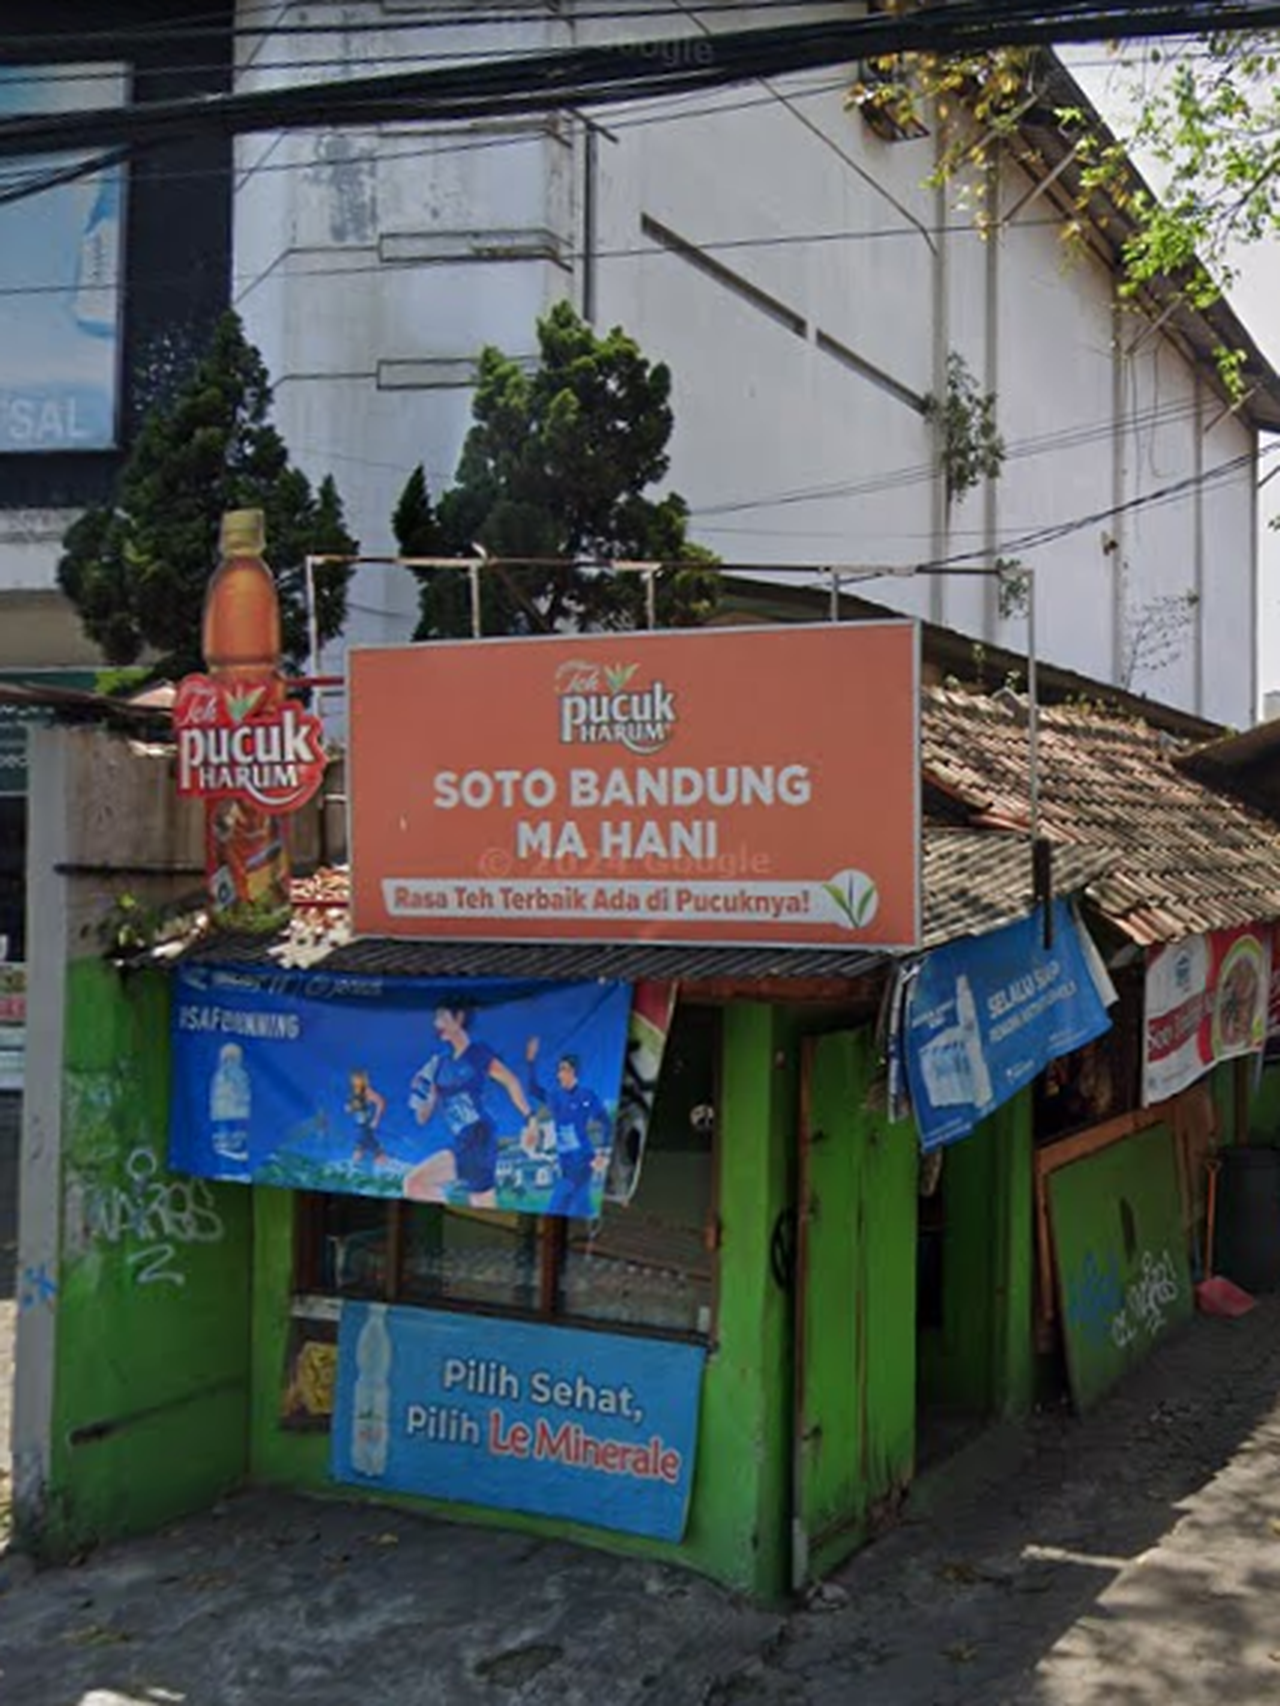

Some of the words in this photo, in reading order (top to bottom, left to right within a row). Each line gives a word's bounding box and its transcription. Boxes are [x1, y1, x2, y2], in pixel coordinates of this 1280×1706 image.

[561, 682, 675, 742] pucuk
[580, 722, 667, 747] HARUM
[180, 710, 314, 790] pucuk
[200, 764, 300, 796] HARUM
[433, 768, 556, 809] SOTO
[569, 764, 811, 807] BANDUNG
[516, 820, 588, 860] MA
[600, 820, 718, 860] HANI
[393, 886, 449, 910] Rasa
[454, 886, 495, 910] Teh
[498, 886, 588, 911] Terbaik
[593, 887, 641, 912] Ada
[645, 887, 669, 912] di
[675, 888, 810, 918] Pucuknya!
[444, 1359, 519, 1399] Pilih
[531, 1372, 643, 1424] Sehat,
[407, 1405, 480, 1444] Pilih
[489, 1408, 532, 1459] Le
[533, 1418, 681, 1484] Minerale
